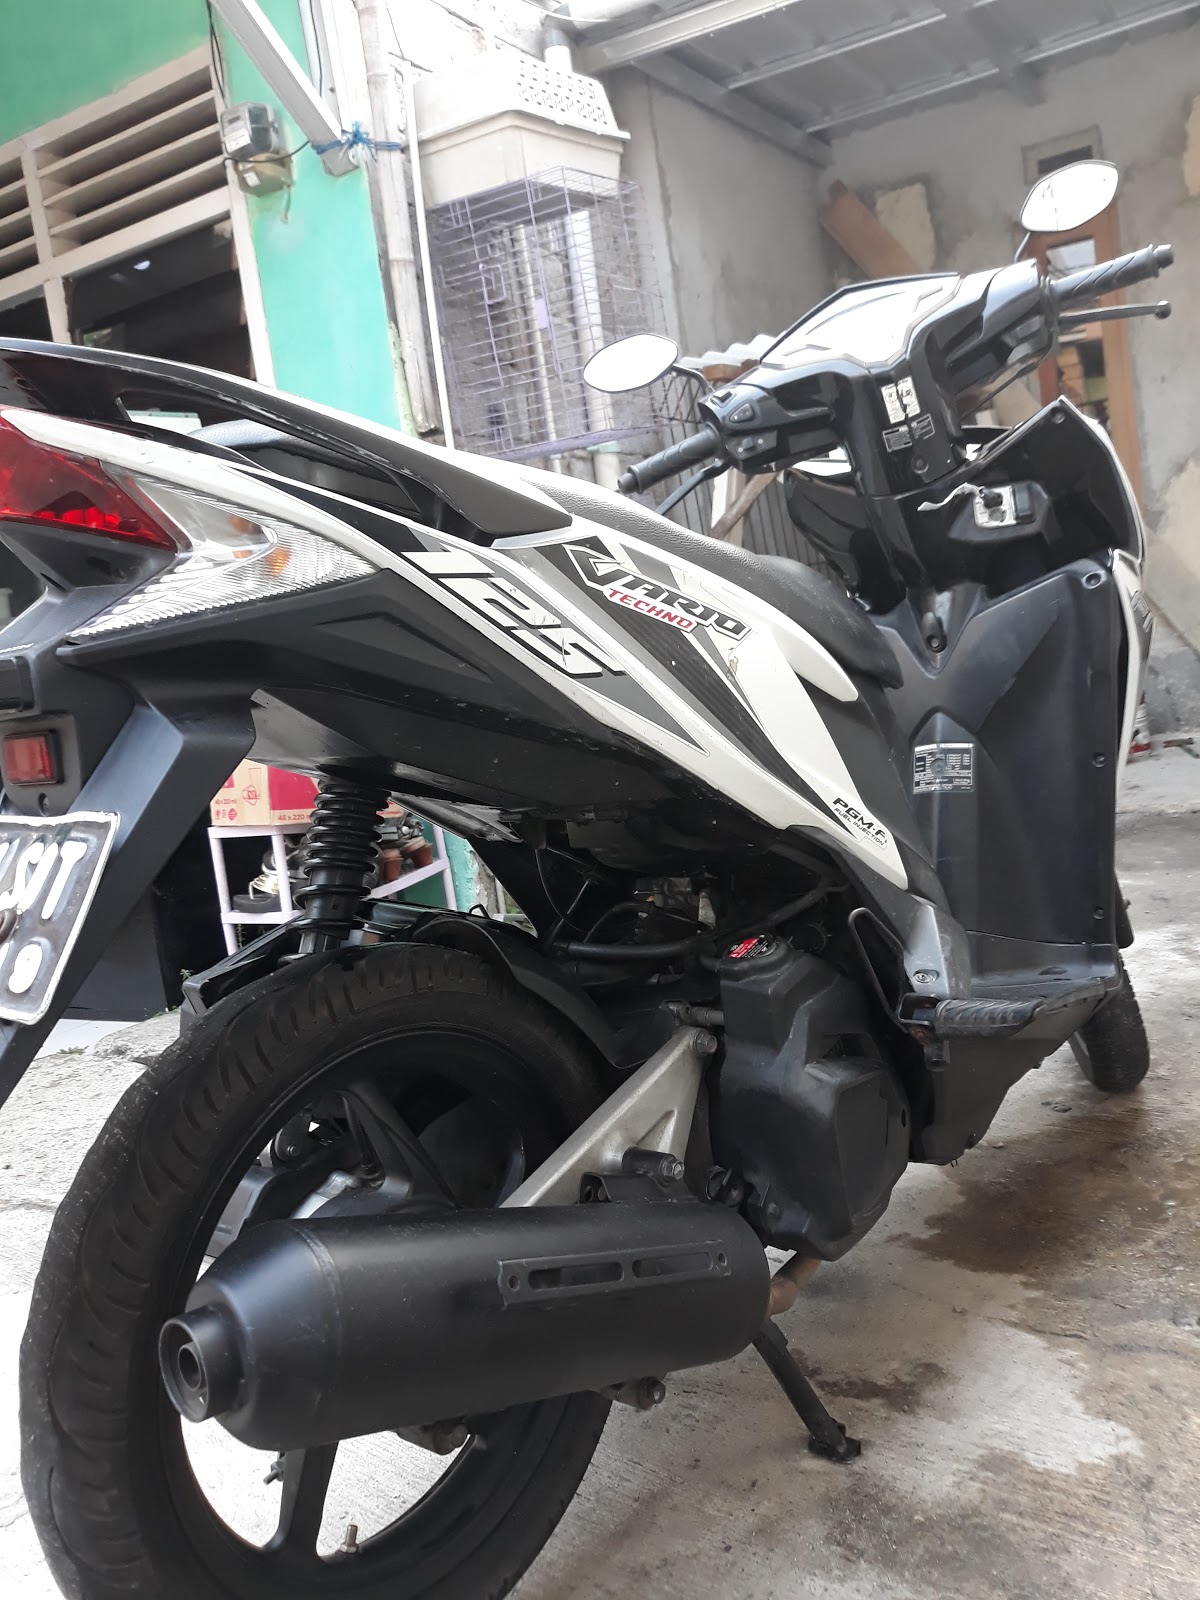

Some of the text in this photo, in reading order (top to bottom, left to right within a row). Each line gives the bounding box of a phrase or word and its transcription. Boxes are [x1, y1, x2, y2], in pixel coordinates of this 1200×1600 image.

[400, 550, 626, 678] 125
[564, 544, 750, 640] VARIO
[608, 587, 694, 630] TECHNO
[834, 807, 885, 846] FUEL INJECTION
